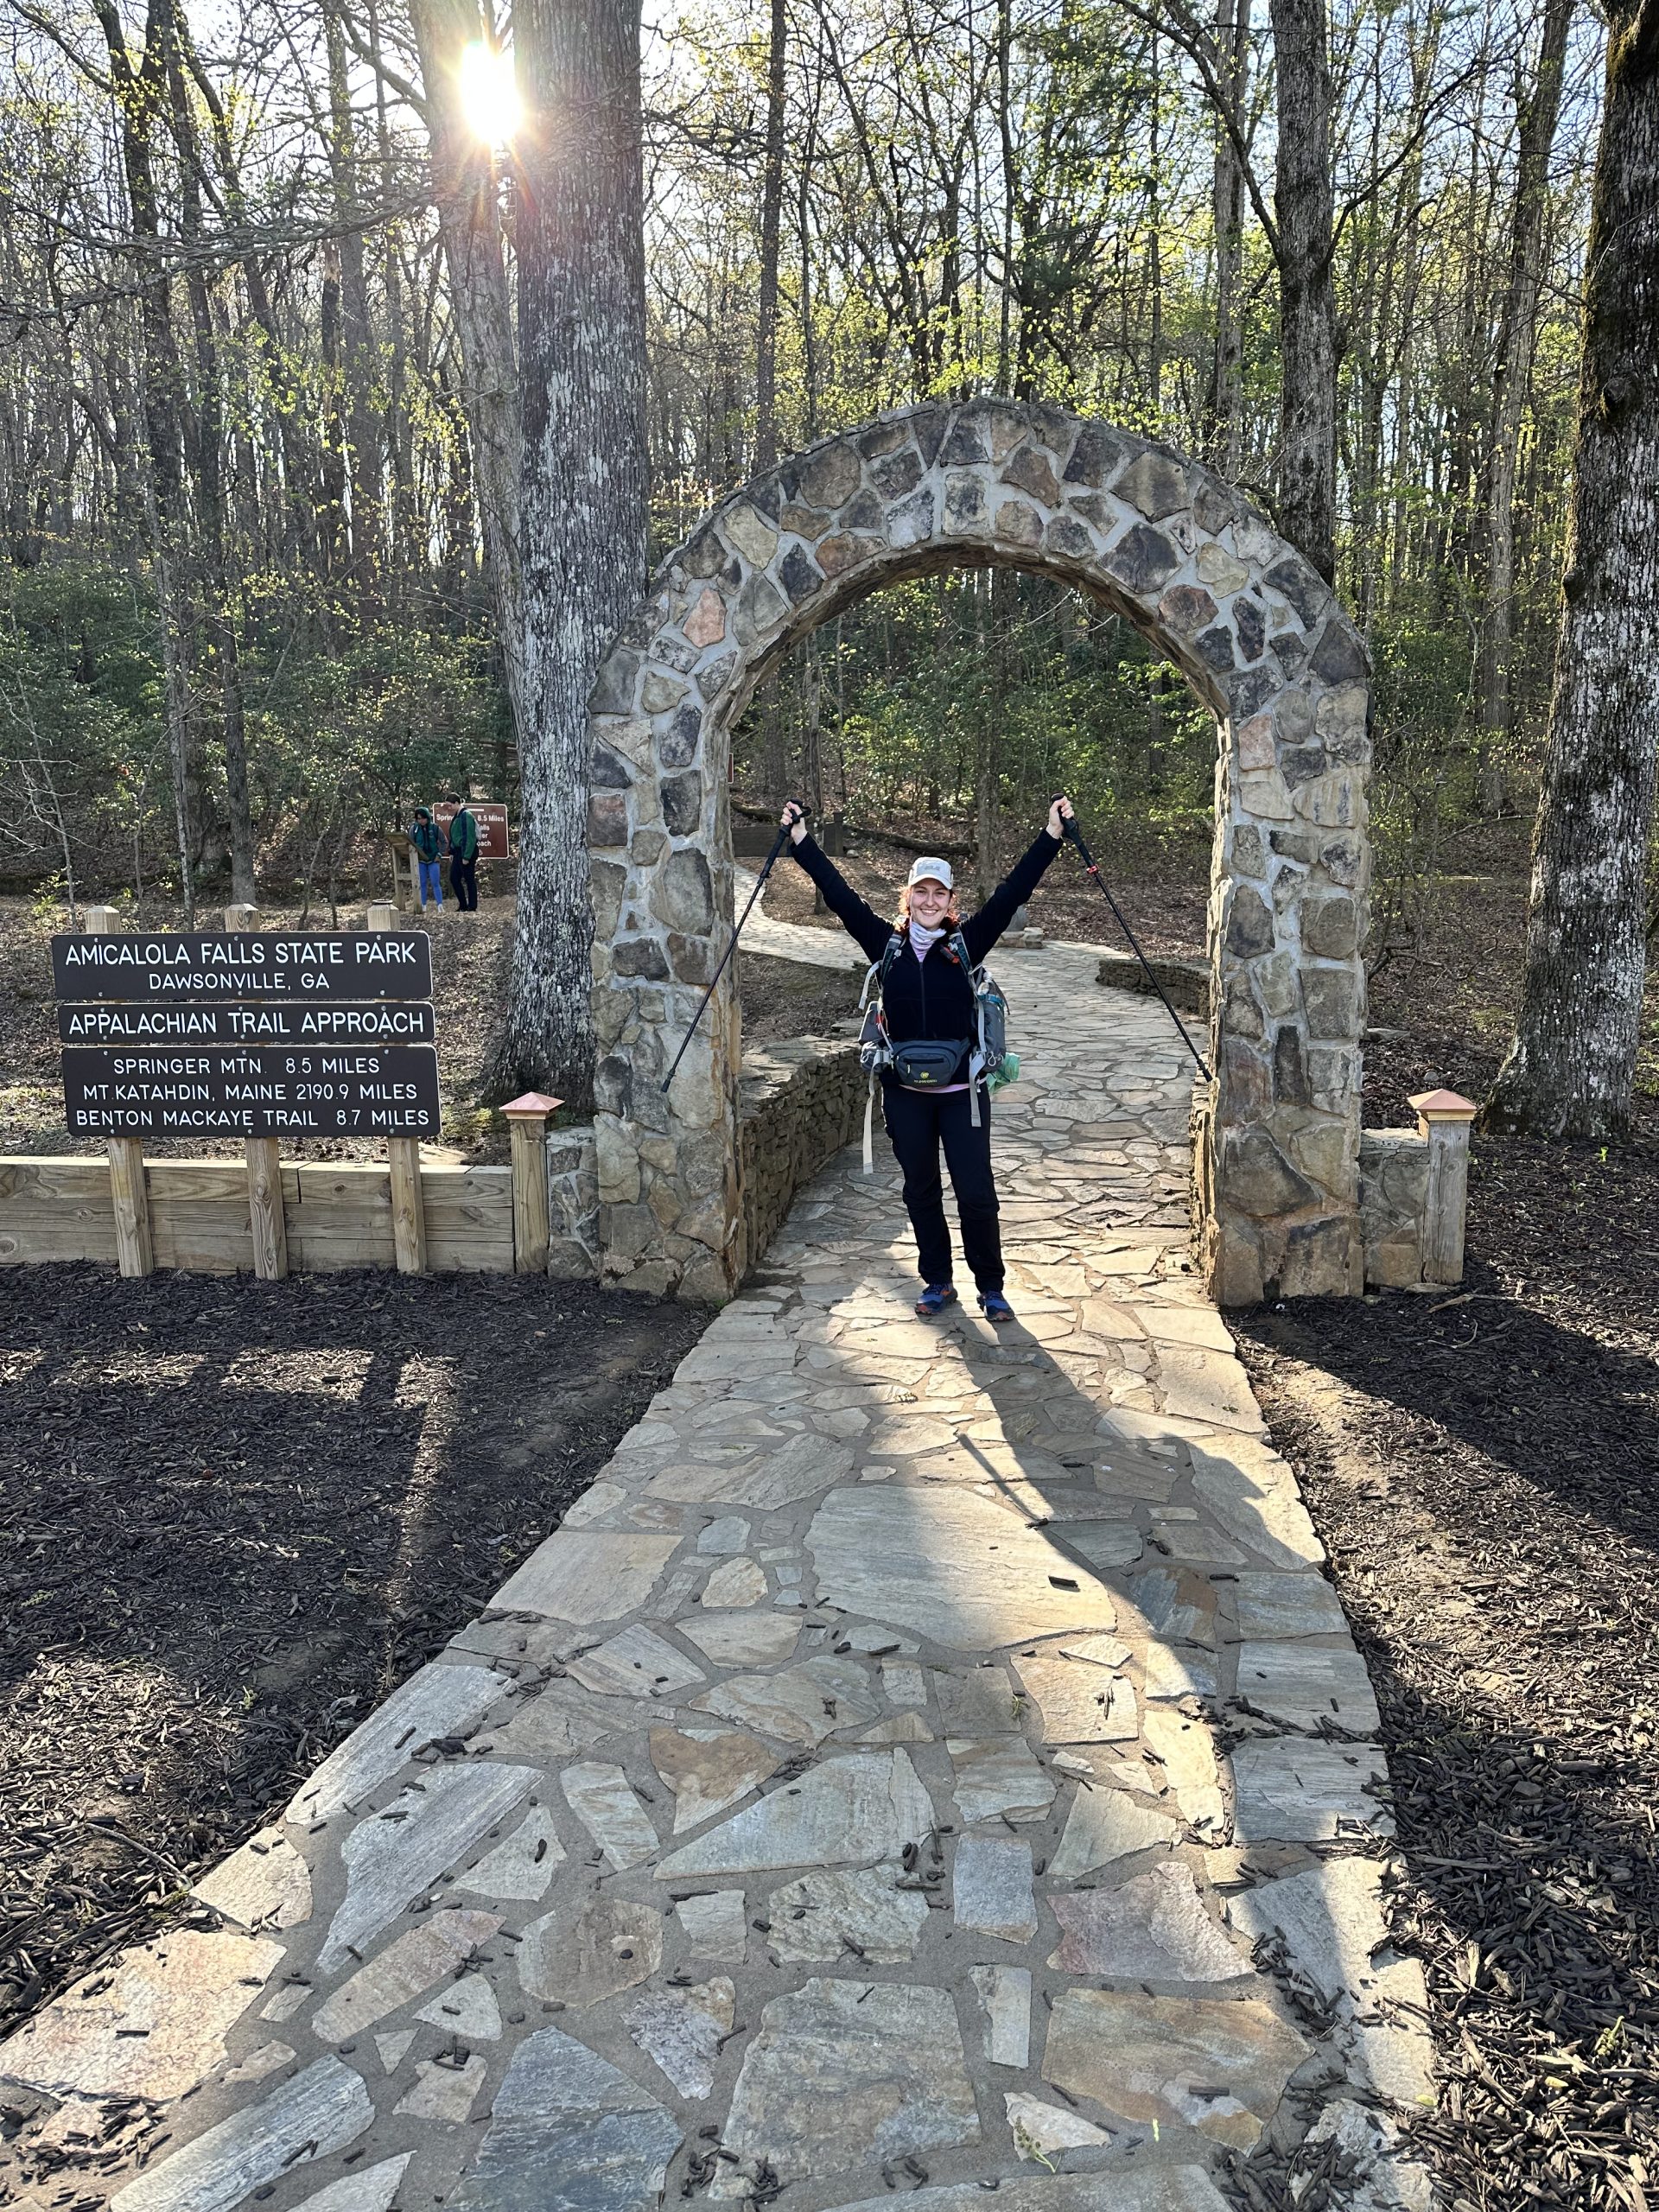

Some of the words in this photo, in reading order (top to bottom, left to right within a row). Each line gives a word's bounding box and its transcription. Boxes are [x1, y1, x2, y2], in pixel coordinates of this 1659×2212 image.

[65, 944, 191, 965] AMICALOLA
[200, 943, 265, 964] FALLS
[275, 942, 344, 964] STATE
[355, 942, 416, 963] PARK
[149, 973, 291, 991] DAWSONVILLE,
[301, 973, 330, 988] GA
[68, 1012, 217, 1034] APPALACHIAN
[228, 1012, 291, 1033] TRAIL
[301, 1012, 424, 1033] APPROACH
[113, 1058, 211, 1074] SPRINGER
[220, 1058, 267, 1074] MTN.
[285, 1058, 312, 1074] 8.5
[321, 1058, 380, 1074] MILES
[226, 1084, 287, 1100] MAINE
[296, 1084, 349, 1100] 2190.9
[359, 1084, 417, 1100] MILES
[76, 1110, 153, 1126] BENTON
[162, 1110, 254, 1126] MACKAYE
[263, 1110, 319, 1126] TRAIL
[336, 1109, 361, 1126] 8.7
[371, 1109, 429, 1126] MILES
